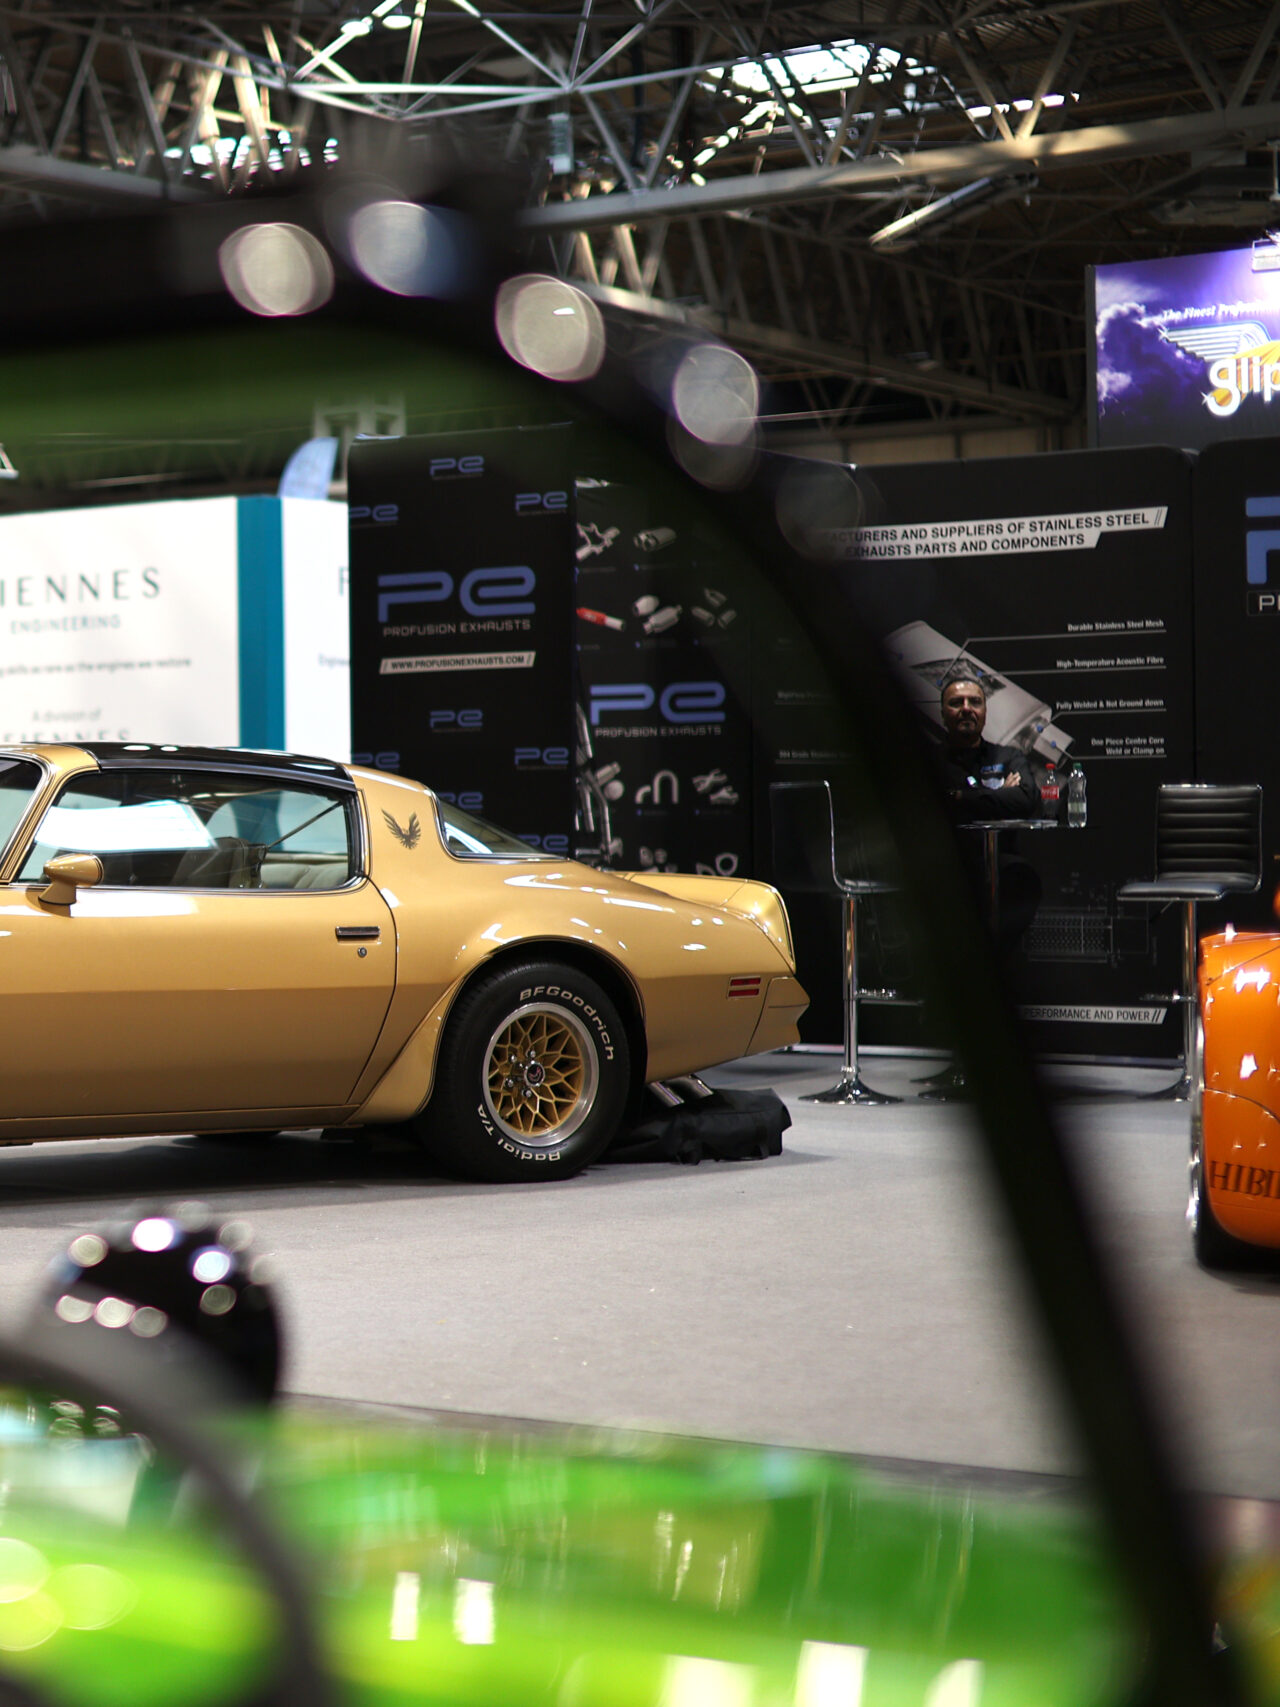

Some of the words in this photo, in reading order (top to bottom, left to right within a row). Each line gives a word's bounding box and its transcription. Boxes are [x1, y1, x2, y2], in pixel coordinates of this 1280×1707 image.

[1184, 306, 1216, 319] Finest
[901, 528, 928, 541] AND
[931, 523, 1004, 539] SUPPLIERS
[1007, 522, 1026, 534] OF
[1029, 516, 1102, 532] STAINLESS
[1106, 512, 1150, 527] STEEL
[915, 542, 957, 555] PARTS
[960, 539, 988, 552] AND
[991, 533, 1085, 551] COMPONENTS
[10, 614, 122, 634] ENGINEERING
[383, 623, 457, 638] PROFUSION
[460, 619, 532, 634] EXHAUSTS
[1067, 622, 1093, 632] Durable
[1095, 621, 1125, 631] Stainless
[1127, 620, 1144, 629] Steel
[1145, 619, 1164, 628] Mesh
[391, 655, 525, 670] WWW.PROFUSIONEXHAUSTS.COM
[1056, 658, 1115, 670] High-Temperature
[1116, 657, 1145, 666] Acoustic
[1147, 656, 1164, 665] Fibre
[1056, 701, 1072, 711] Fully
[1073, 700, 1098, 709] Welded
[1106, 700, 1118, 709] Not
[1119, 699, 1143, 708] Ground
[1145, 698, 1164, 707] down
[595, 726, 658, 738] PROFUSION
[660, 725, 722, 737] EXHAUSTS
[1105, 737, 1123, 746] Piece
[1125, 737, 1148, 746] Centre
[1148, 736, 1164, 745] Core
[1106, 747, 1122, 756] Weld
[1132, 747, 1154, 756] Clamp
[1094, 1009, 1114, 1020] AND
[1116, 1010, 1150, 1021] POWER
[519, 986, 614, 1061] BFGoodrich
[477, 1103, 494, 1137] T/A
[497, 1138, 561, 1162] Radial
